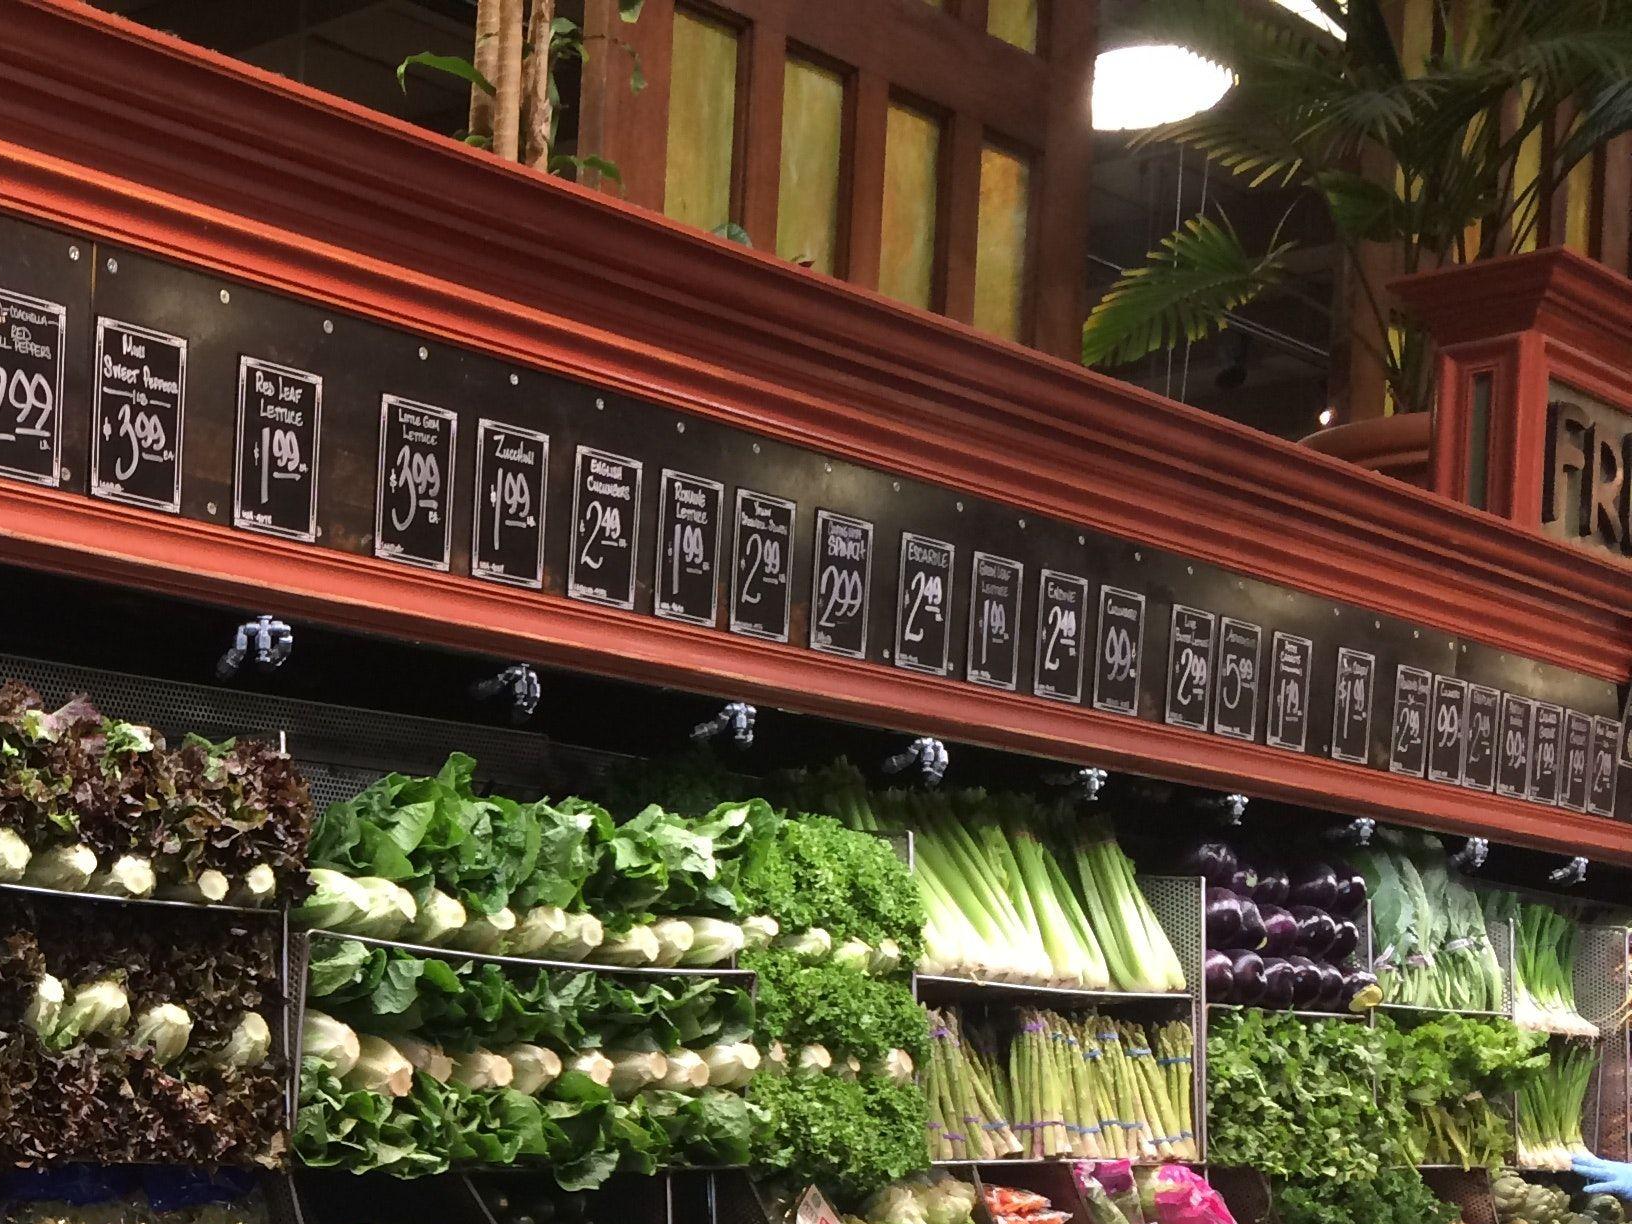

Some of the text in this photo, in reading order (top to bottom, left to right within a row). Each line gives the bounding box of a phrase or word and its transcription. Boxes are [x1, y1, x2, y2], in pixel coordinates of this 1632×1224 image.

[11, 325, 31, 341] RED
[14, 337, 52, 360] PEPPERS
[103, 355, 179, 394] SWEET PEPPERS
[255, 370, 303, 405] RED LEAF
[260, 398, 304, 427] LETTUCE
[403, 426, 438, 446] LETTUCE
[1542, 400, 1632, 560] FR
